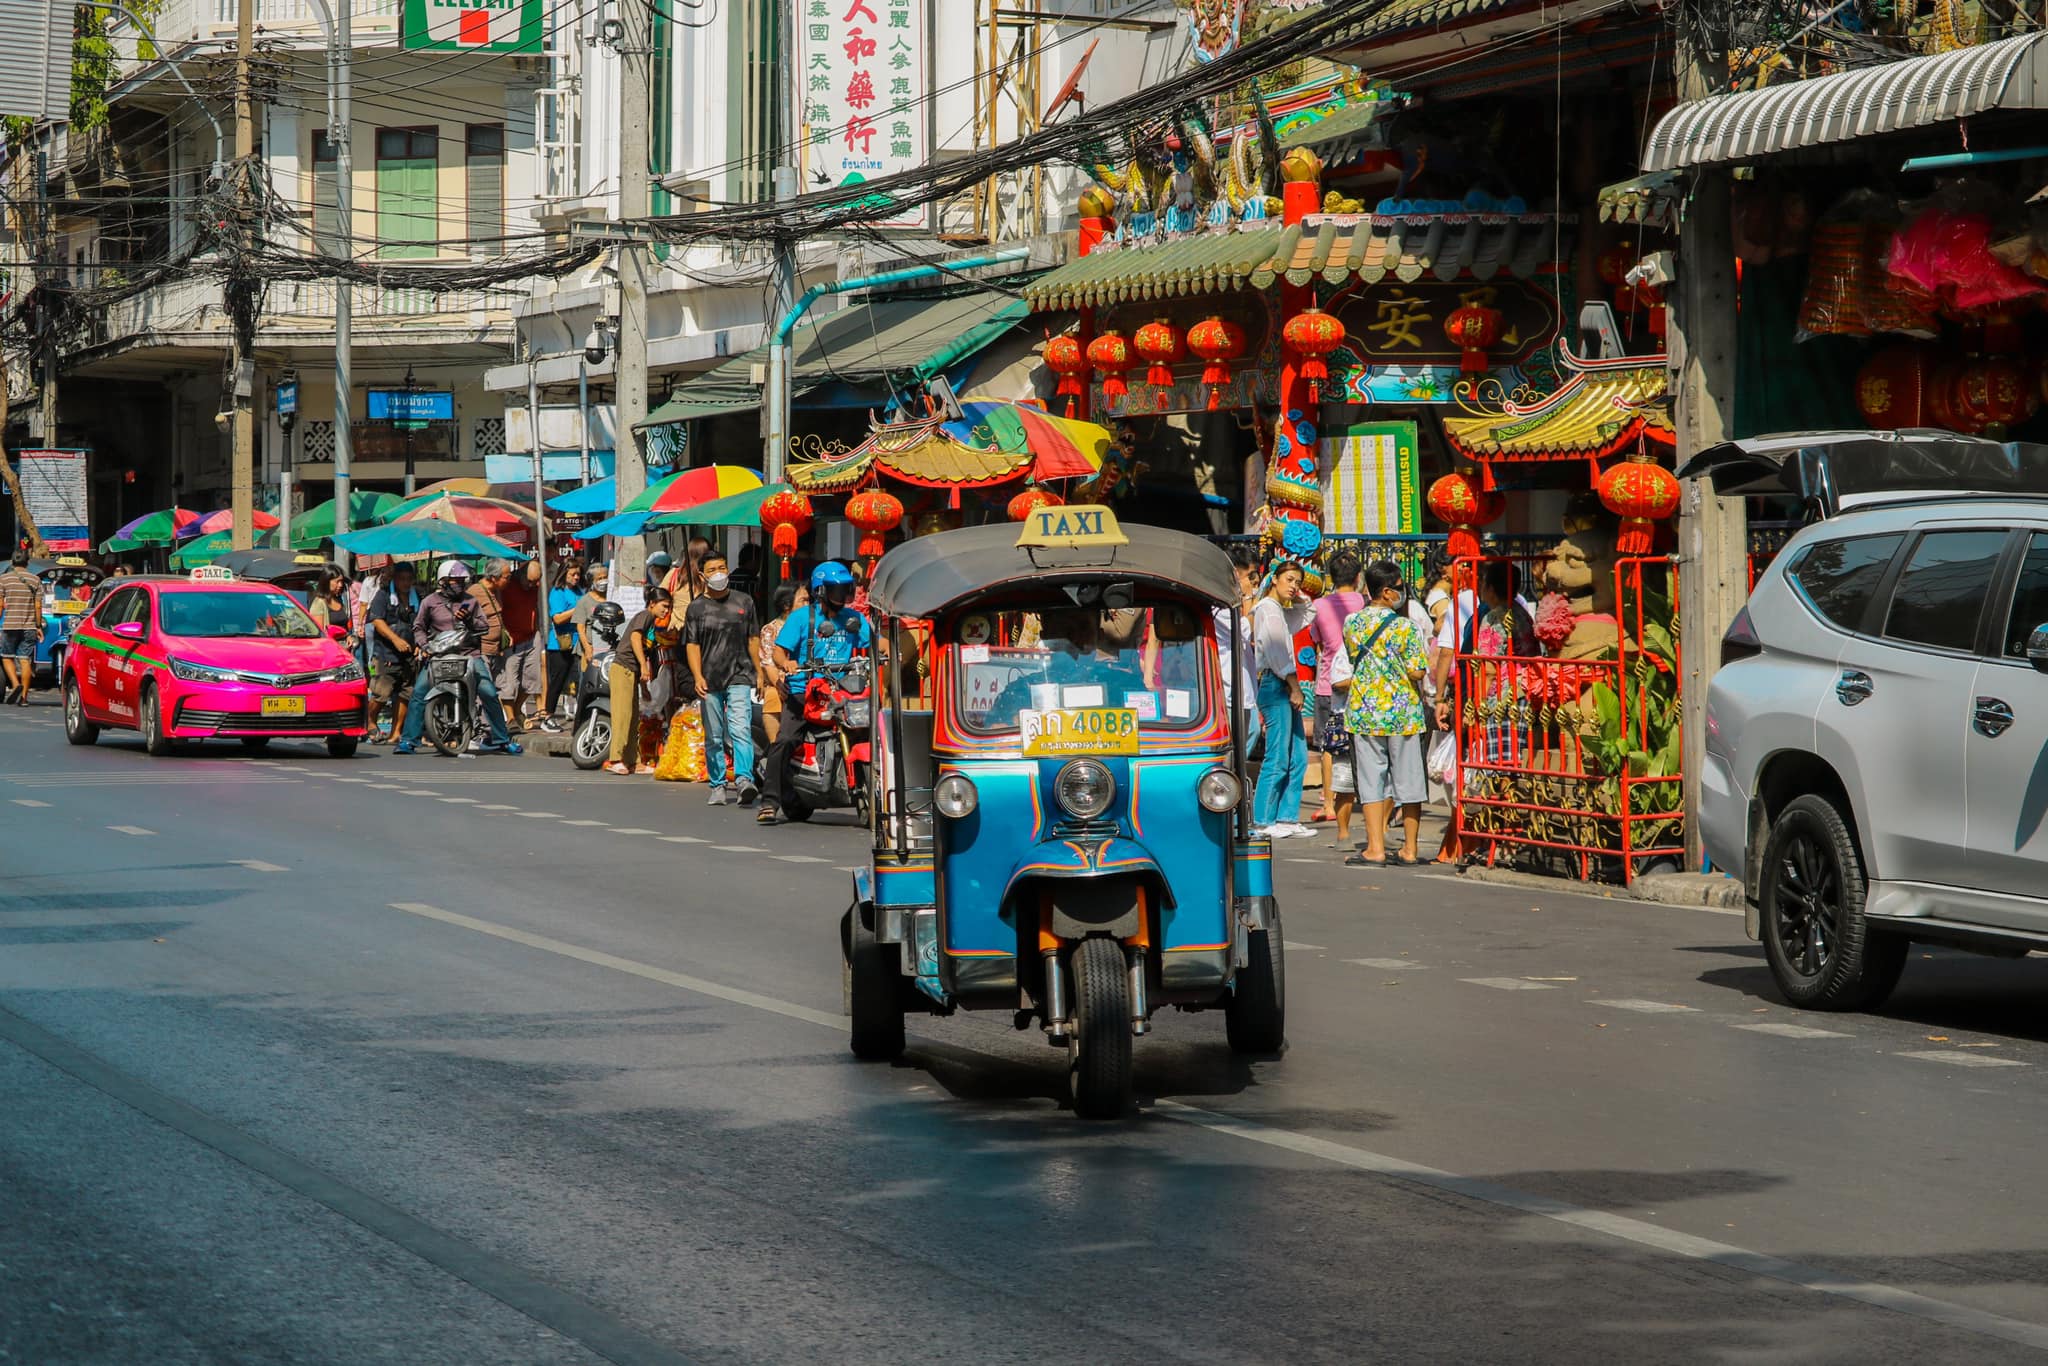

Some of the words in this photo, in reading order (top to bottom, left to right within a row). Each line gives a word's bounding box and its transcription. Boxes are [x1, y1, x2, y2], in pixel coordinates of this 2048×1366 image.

[842, 0, 878, 155] 人和藥行
[1367, 288, 1433, 349] 安
[1465, 317, 1483, 336] 財
[1036, 511, 1105, 537] TAXI
[203, 568, 222, 578] TAXI
[1072, 711, 1133, 734] 4088
